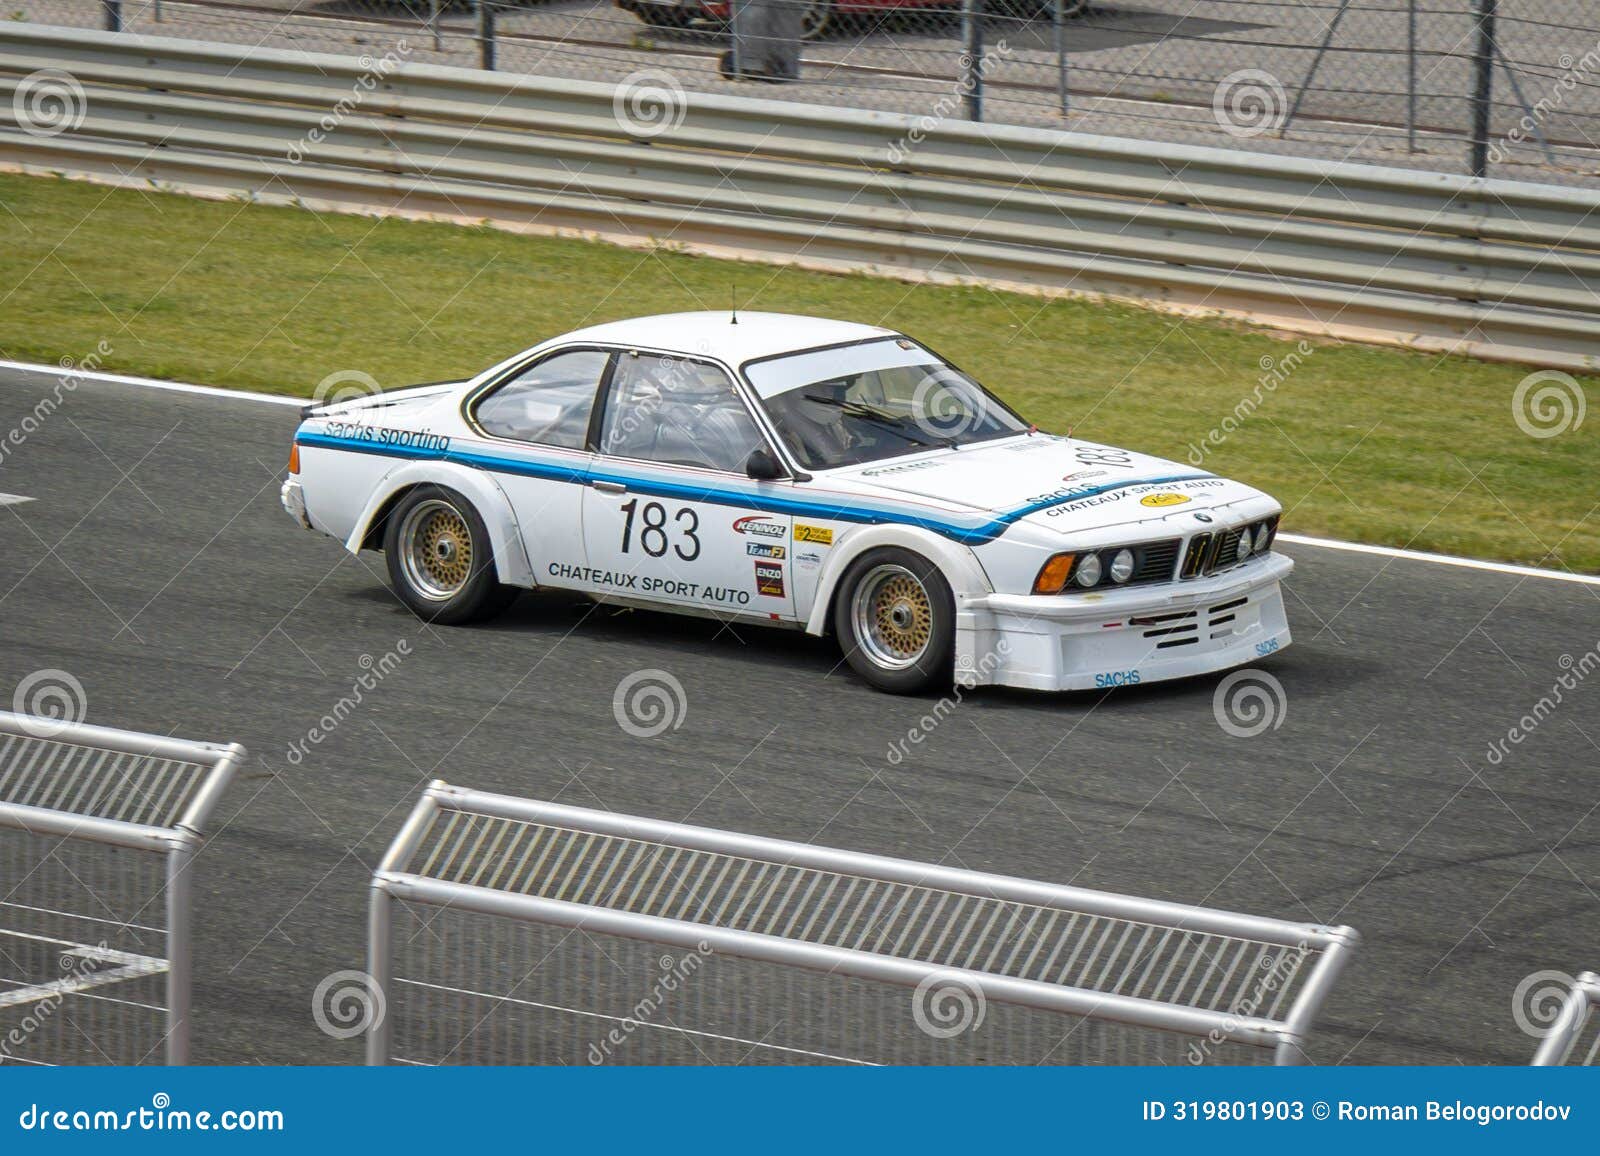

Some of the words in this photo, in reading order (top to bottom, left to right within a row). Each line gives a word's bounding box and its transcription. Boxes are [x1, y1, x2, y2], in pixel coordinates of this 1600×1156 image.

[324, 421, 374, 441] sachs
[378, 428, 450, 451] sporting
[1075, 447, 1134, 468] 183
[1026, 481, 1099, 506] sachs
[1046, 489, 1131, 517] CHATEAUX
[1131, 484, 1181, 494] SPORT
[1184, 480, 1225, 489] AUTO
[620, 498, 701, 562] 183
[736, 520, 785, 535] KENNOL
[549, 562, 638, 589] CHATEAUX
[641, 576, 699, 597] SPORT
[701, 586, 750, 605] AUTO
[756, 567, 782, 579] ENZO
[1256, 637, 1279, 657] SACHS
[1095, 669, 1141, 688] SACHS
